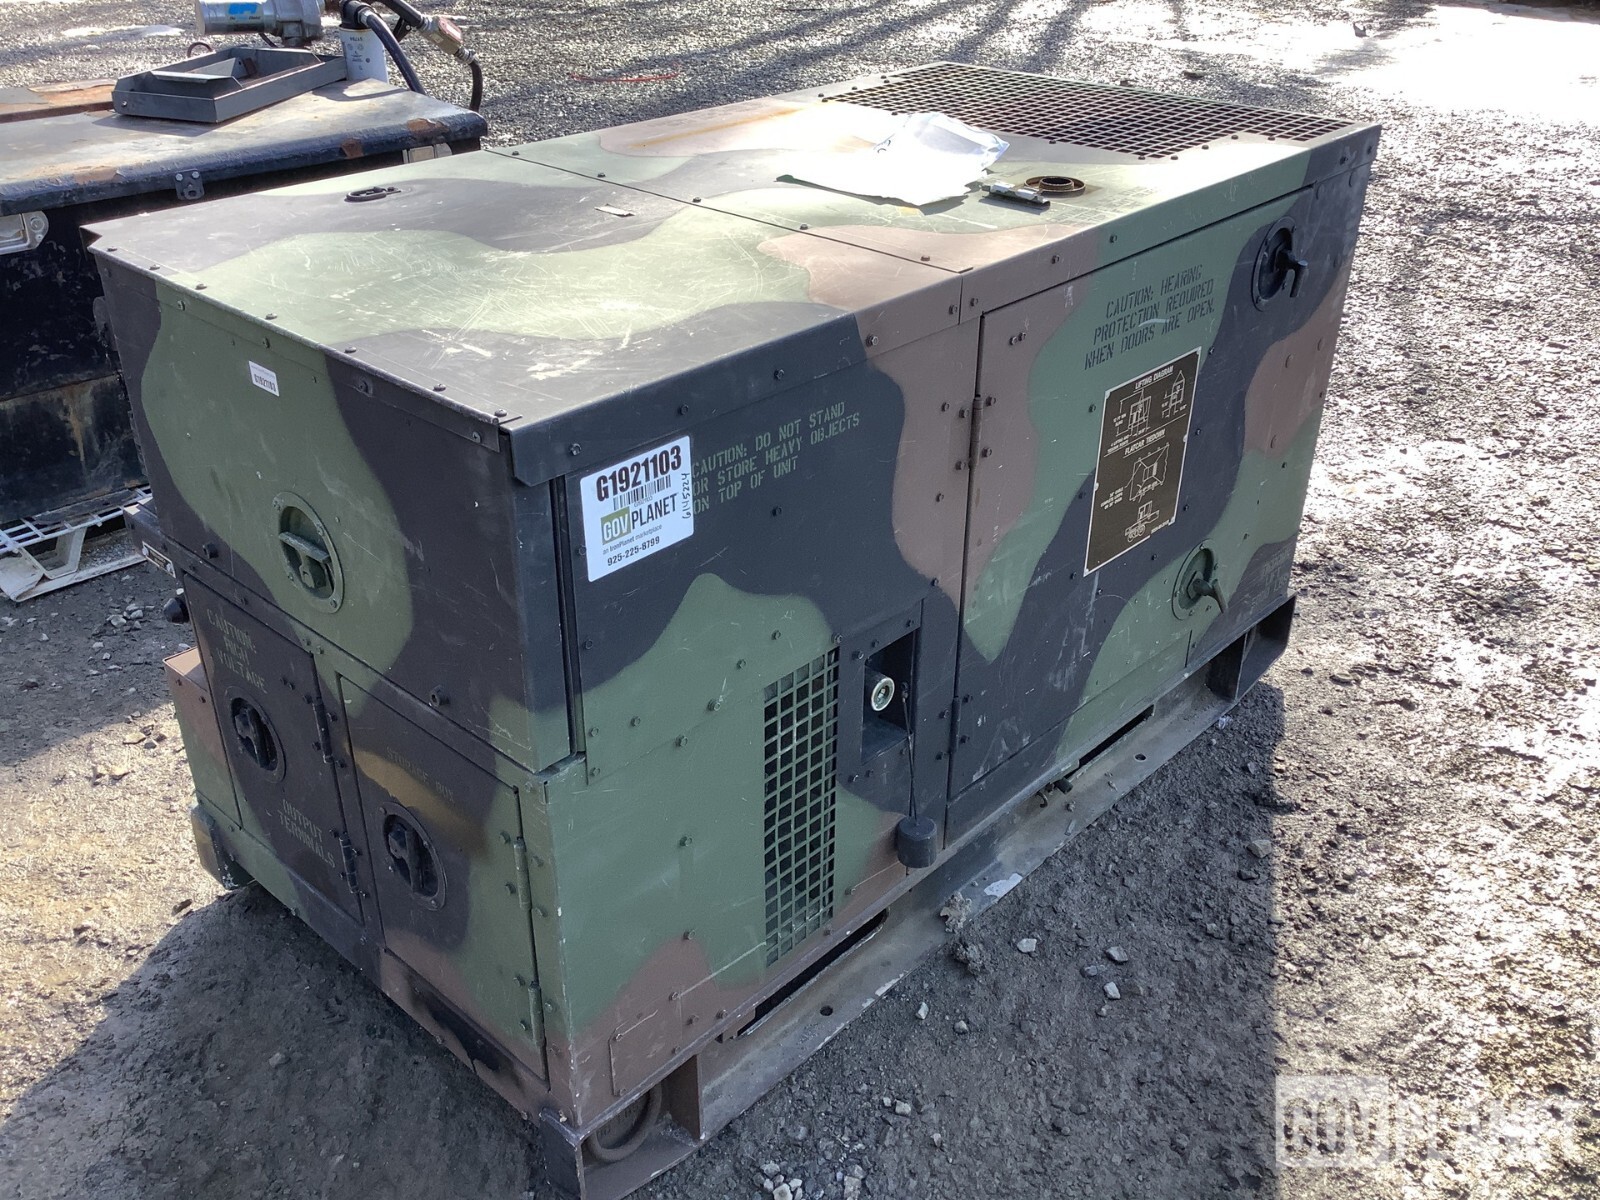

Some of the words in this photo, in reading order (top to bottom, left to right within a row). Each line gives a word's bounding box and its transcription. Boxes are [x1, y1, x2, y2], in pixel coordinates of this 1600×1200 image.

[1093, 301, 1160, 345] PROTECTION
[1165, 279, 1214, 314] REQUIRED
[1106, 285, 1154, 319] CAUTION:
[1160, 264, 1203, 296] HEARING
[1084, 341, 1115, 370] WHEN
[1120, 324, 1155, 353] DOORS
[1161, 312, 1182, 336] ARE
[1135, 375, 1153, 390] LIFTING
[1153, 365, 1174, 381] DIAGRAM
[692, 443, 748, 478] CAUTION:
[755, 432, 771, 451] DO
[779, 419, 802, 441] NOT
[809, 402, 846, 429] STAND
[692, 477, 709, 496] OR
[718, 456, 757, 486] STORE
[766, 436, 803, 465] HEAVY
[810, 412, 860, 445] OBJECTS
[1125, 440, 1145, 455] FLATCAR
[596, 445, 682, 502] G1921103
[693, 495, 710, 515] ON
[718, 481, 742, 503] TOP
[750, 470, 766, 489] OF
[773, 455, 799, 479] UNIT
[603, 513, 629, 542] GOV
[631, 493, 678, 530] PLANET
[610, 536, 635, 552] IronPlanet
[635, 524, 662, 541] marketplace
[607, 536, 660, 566] 925-225-8799
[215, 647, 268, 694] VOLTAGE
[277, 809, 336, 868] TERMINALS
[282, 799, 322, 843] OUTPUT
